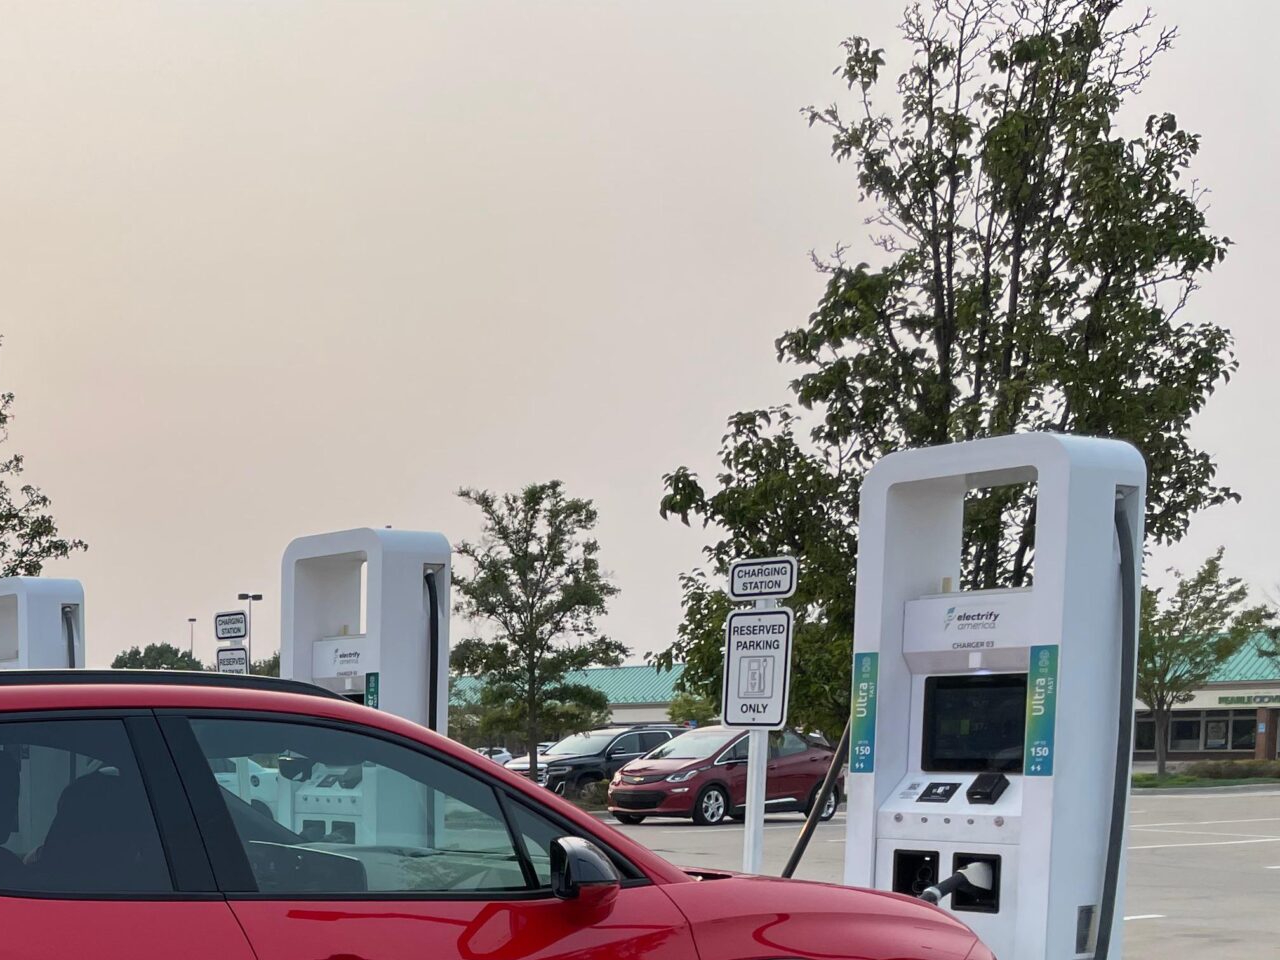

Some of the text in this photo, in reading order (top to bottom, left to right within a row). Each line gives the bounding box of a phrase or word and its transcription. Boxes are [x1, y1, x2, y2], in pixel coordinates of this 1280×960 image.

[737, 566, 788, 579] CHARGING
[742, 580, 781, 591] STATION
[218, 617, 243, 626] CHARGING
[957, 611, 1000, 622] electrify
[733, 624, 785, 636] RESERVED
[957, 622, 996, 630] america
[736, 640, 780, 651] PARKING
[220, 657, 245, 666] RESERVED
[856, 682, 868, 718] Ultra
[1032, 678, 1046, 716] Ultra
[740, 703, 768, 714] ONLY
[855, 746, 871, 755] 150
[1030, 747, 1049, 757] 150
